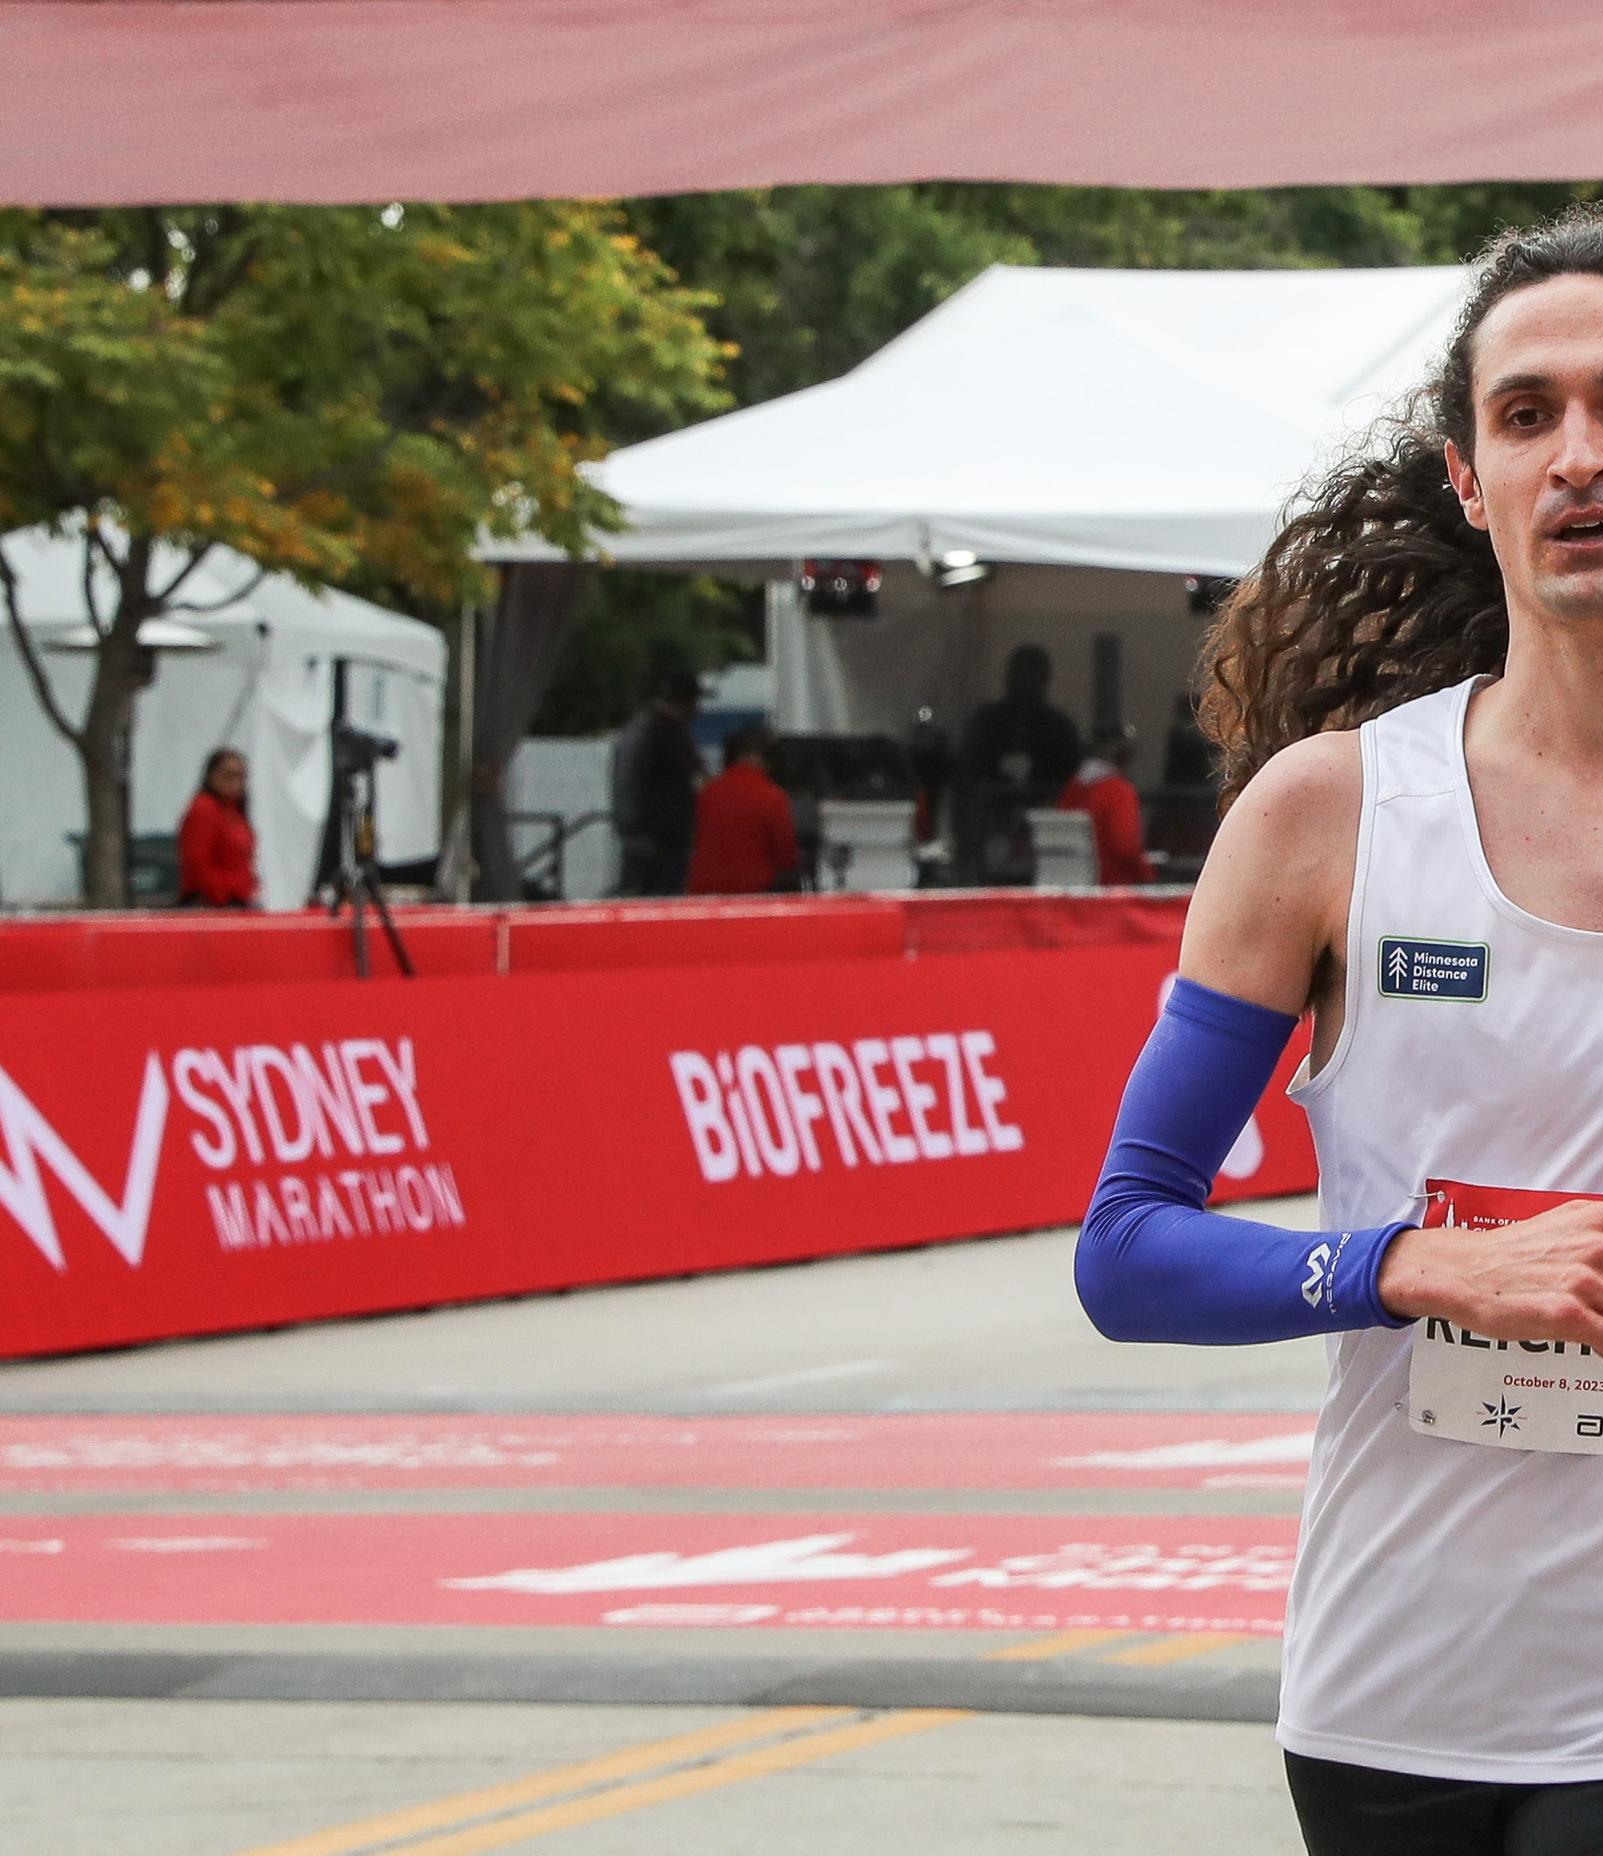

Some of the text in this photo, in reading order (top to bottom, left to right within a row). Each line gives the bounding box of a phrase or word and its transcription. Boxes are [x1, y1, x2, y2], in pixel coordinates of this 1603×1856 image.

[1414, 951, 1478, 967] Minnesota
[1413, 965, 1468, 981] Distance
[1412, 979, 1439, 992] Elite
[172, 1037, 429, 1170] SYDNEY
[206, 1164, 466, 1252] MARATHON
[1473, 1215, 1496, 1225] BANK
[1503, 1374, 1555, 1389] October
[1558, 1379, 1571, 1391] 8,
